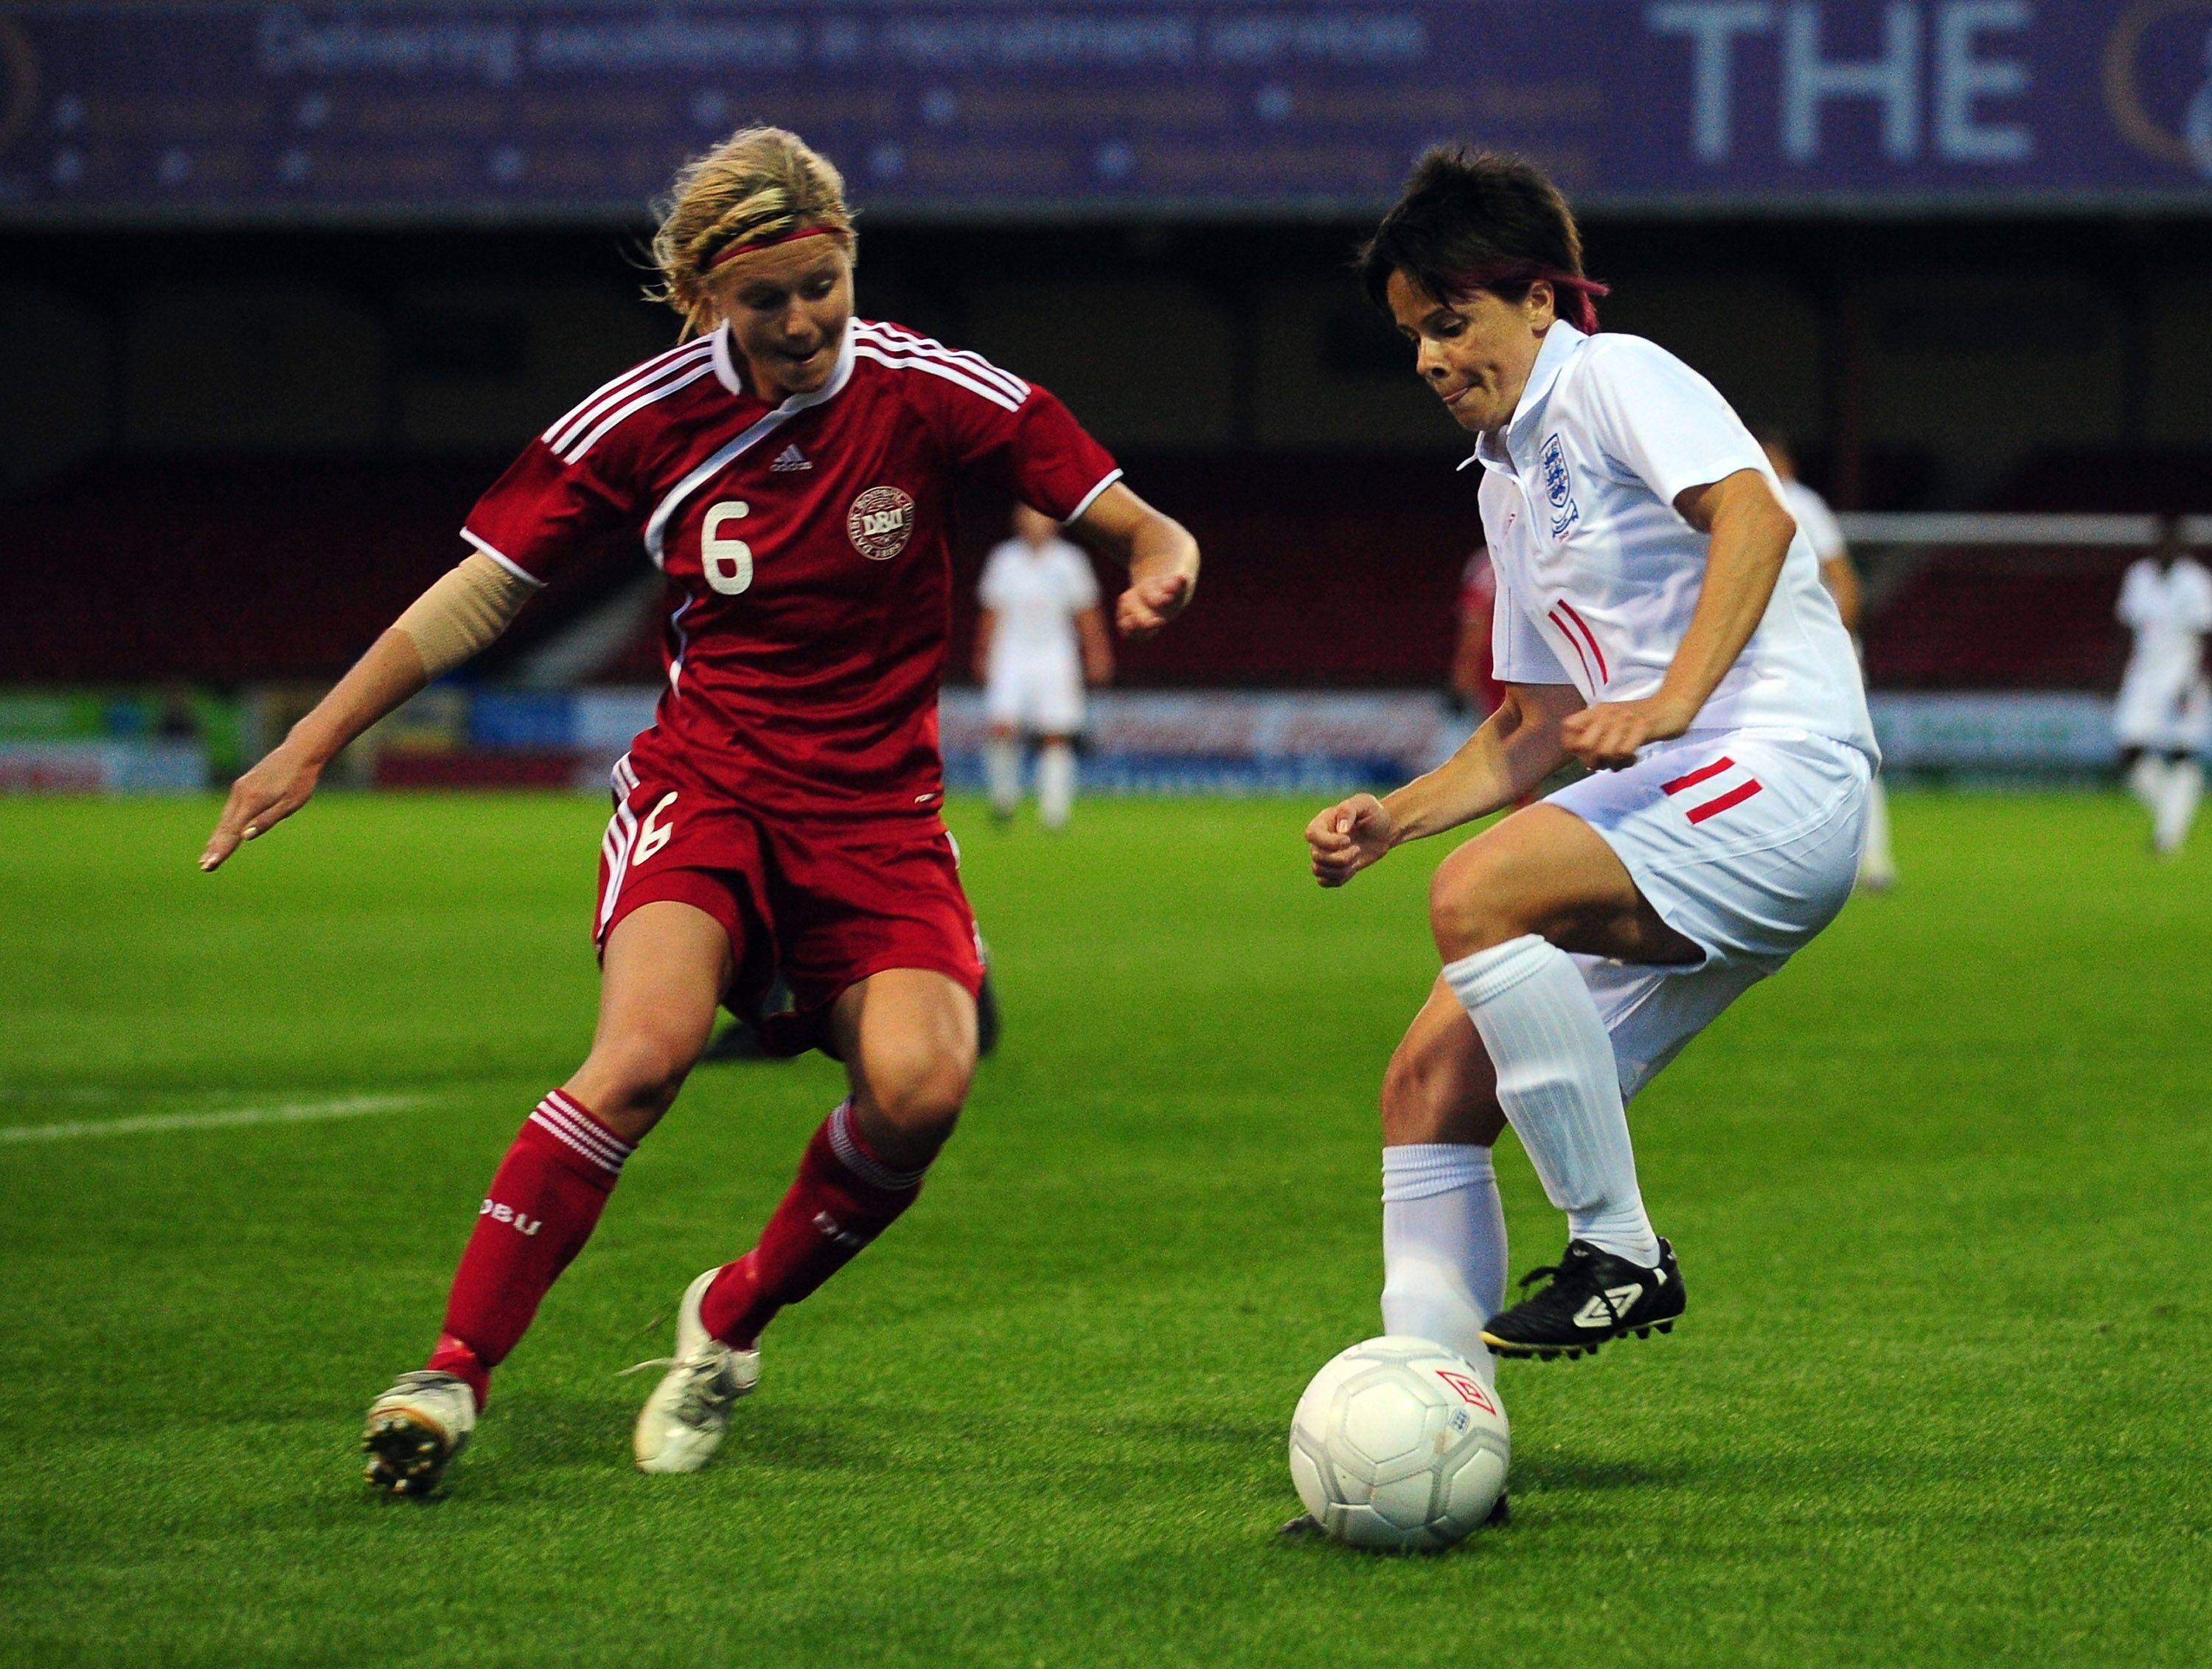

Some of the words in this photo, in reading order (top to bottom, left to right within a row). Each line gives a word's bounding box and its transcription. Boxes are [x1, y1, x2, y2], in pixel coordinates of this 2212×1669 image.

[1646, 1, 2034, 161] THE
[701, 501, 754, 595] 6
[1548, 598, 1608, 696] 11
[632, 791, 678, 867] 6
[1661, 756, 1763, 825] 11
[479, 1198, 543, 1236] DBU
